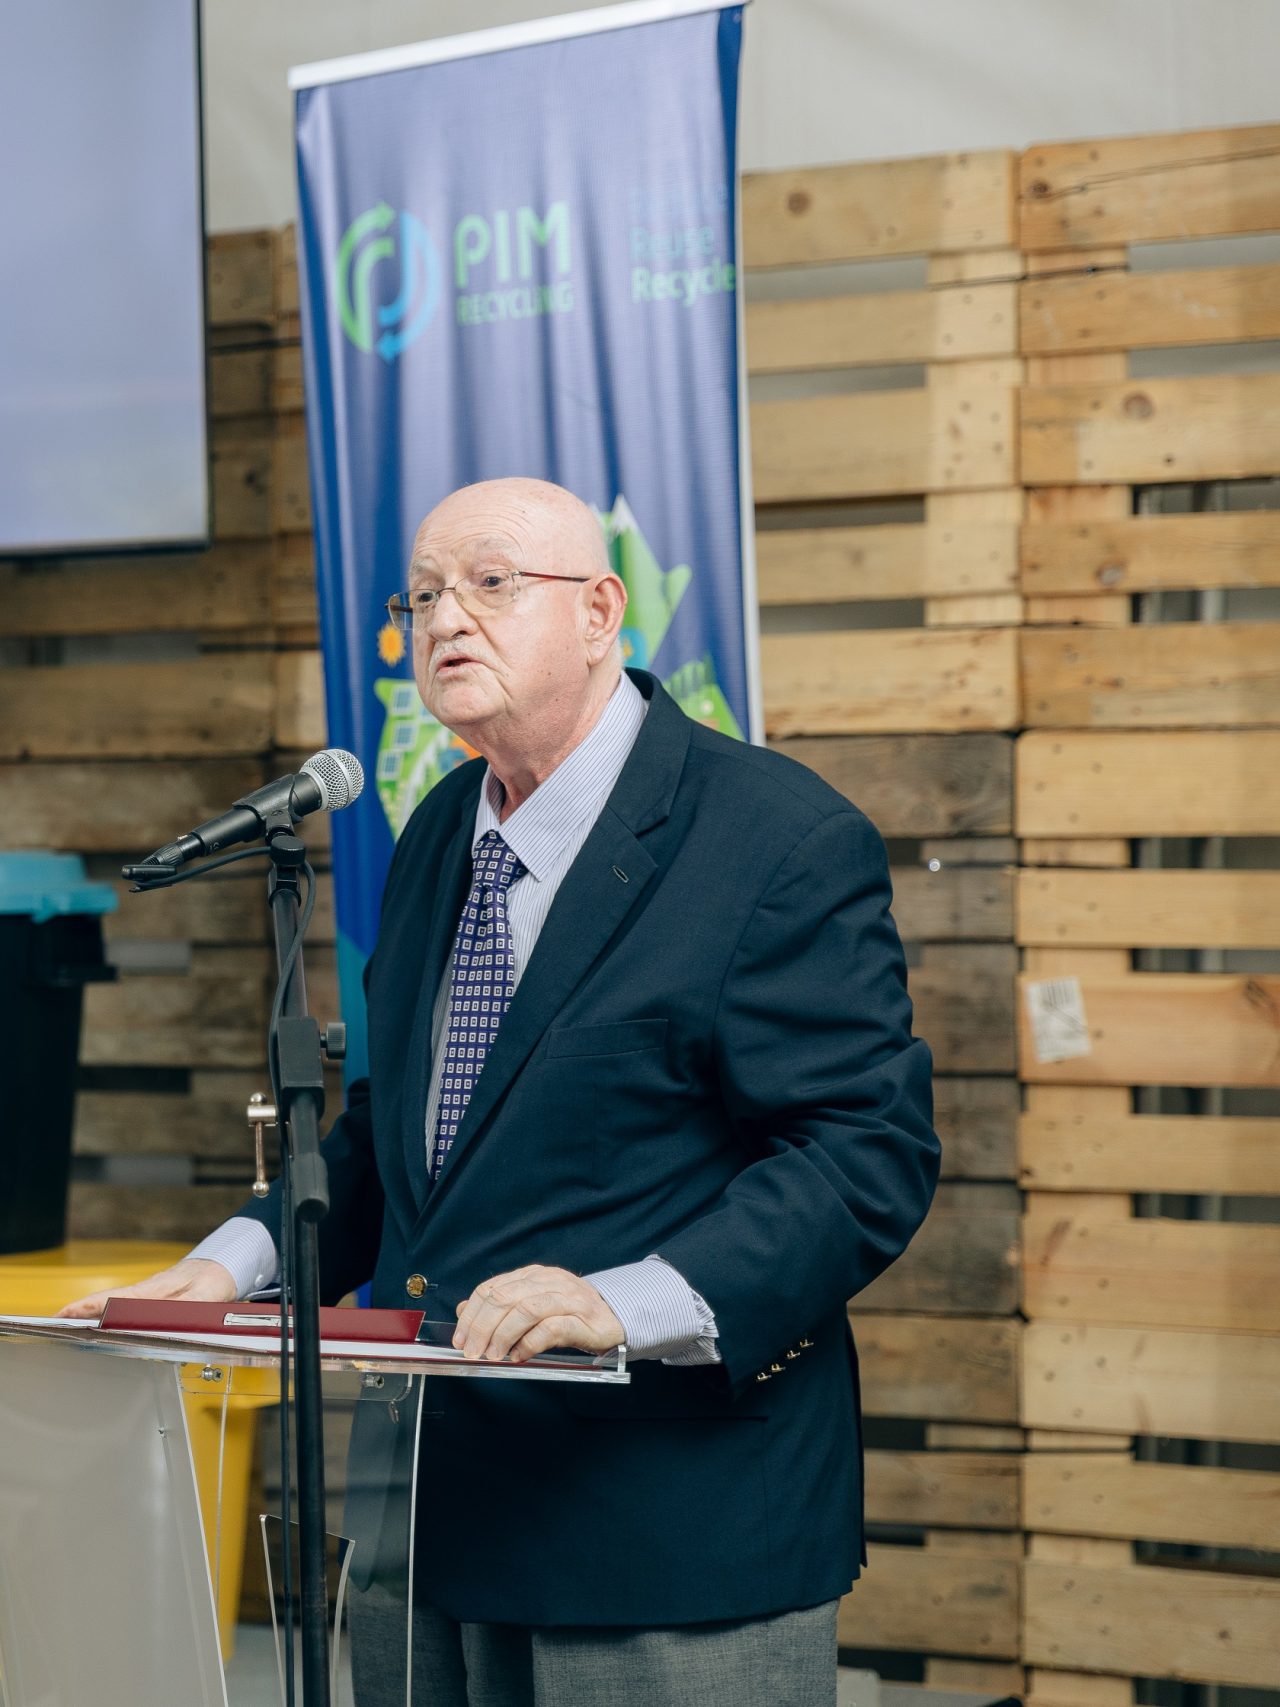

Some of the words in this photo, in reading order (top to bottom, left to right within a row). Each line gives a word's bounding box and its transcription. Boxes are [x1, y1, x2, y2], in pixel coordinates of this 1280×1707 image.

[453, 200, 572, 289] PIM
[455, 282, 576, 327] RECYCLING
[629, 258, 736, 307] Recycle
